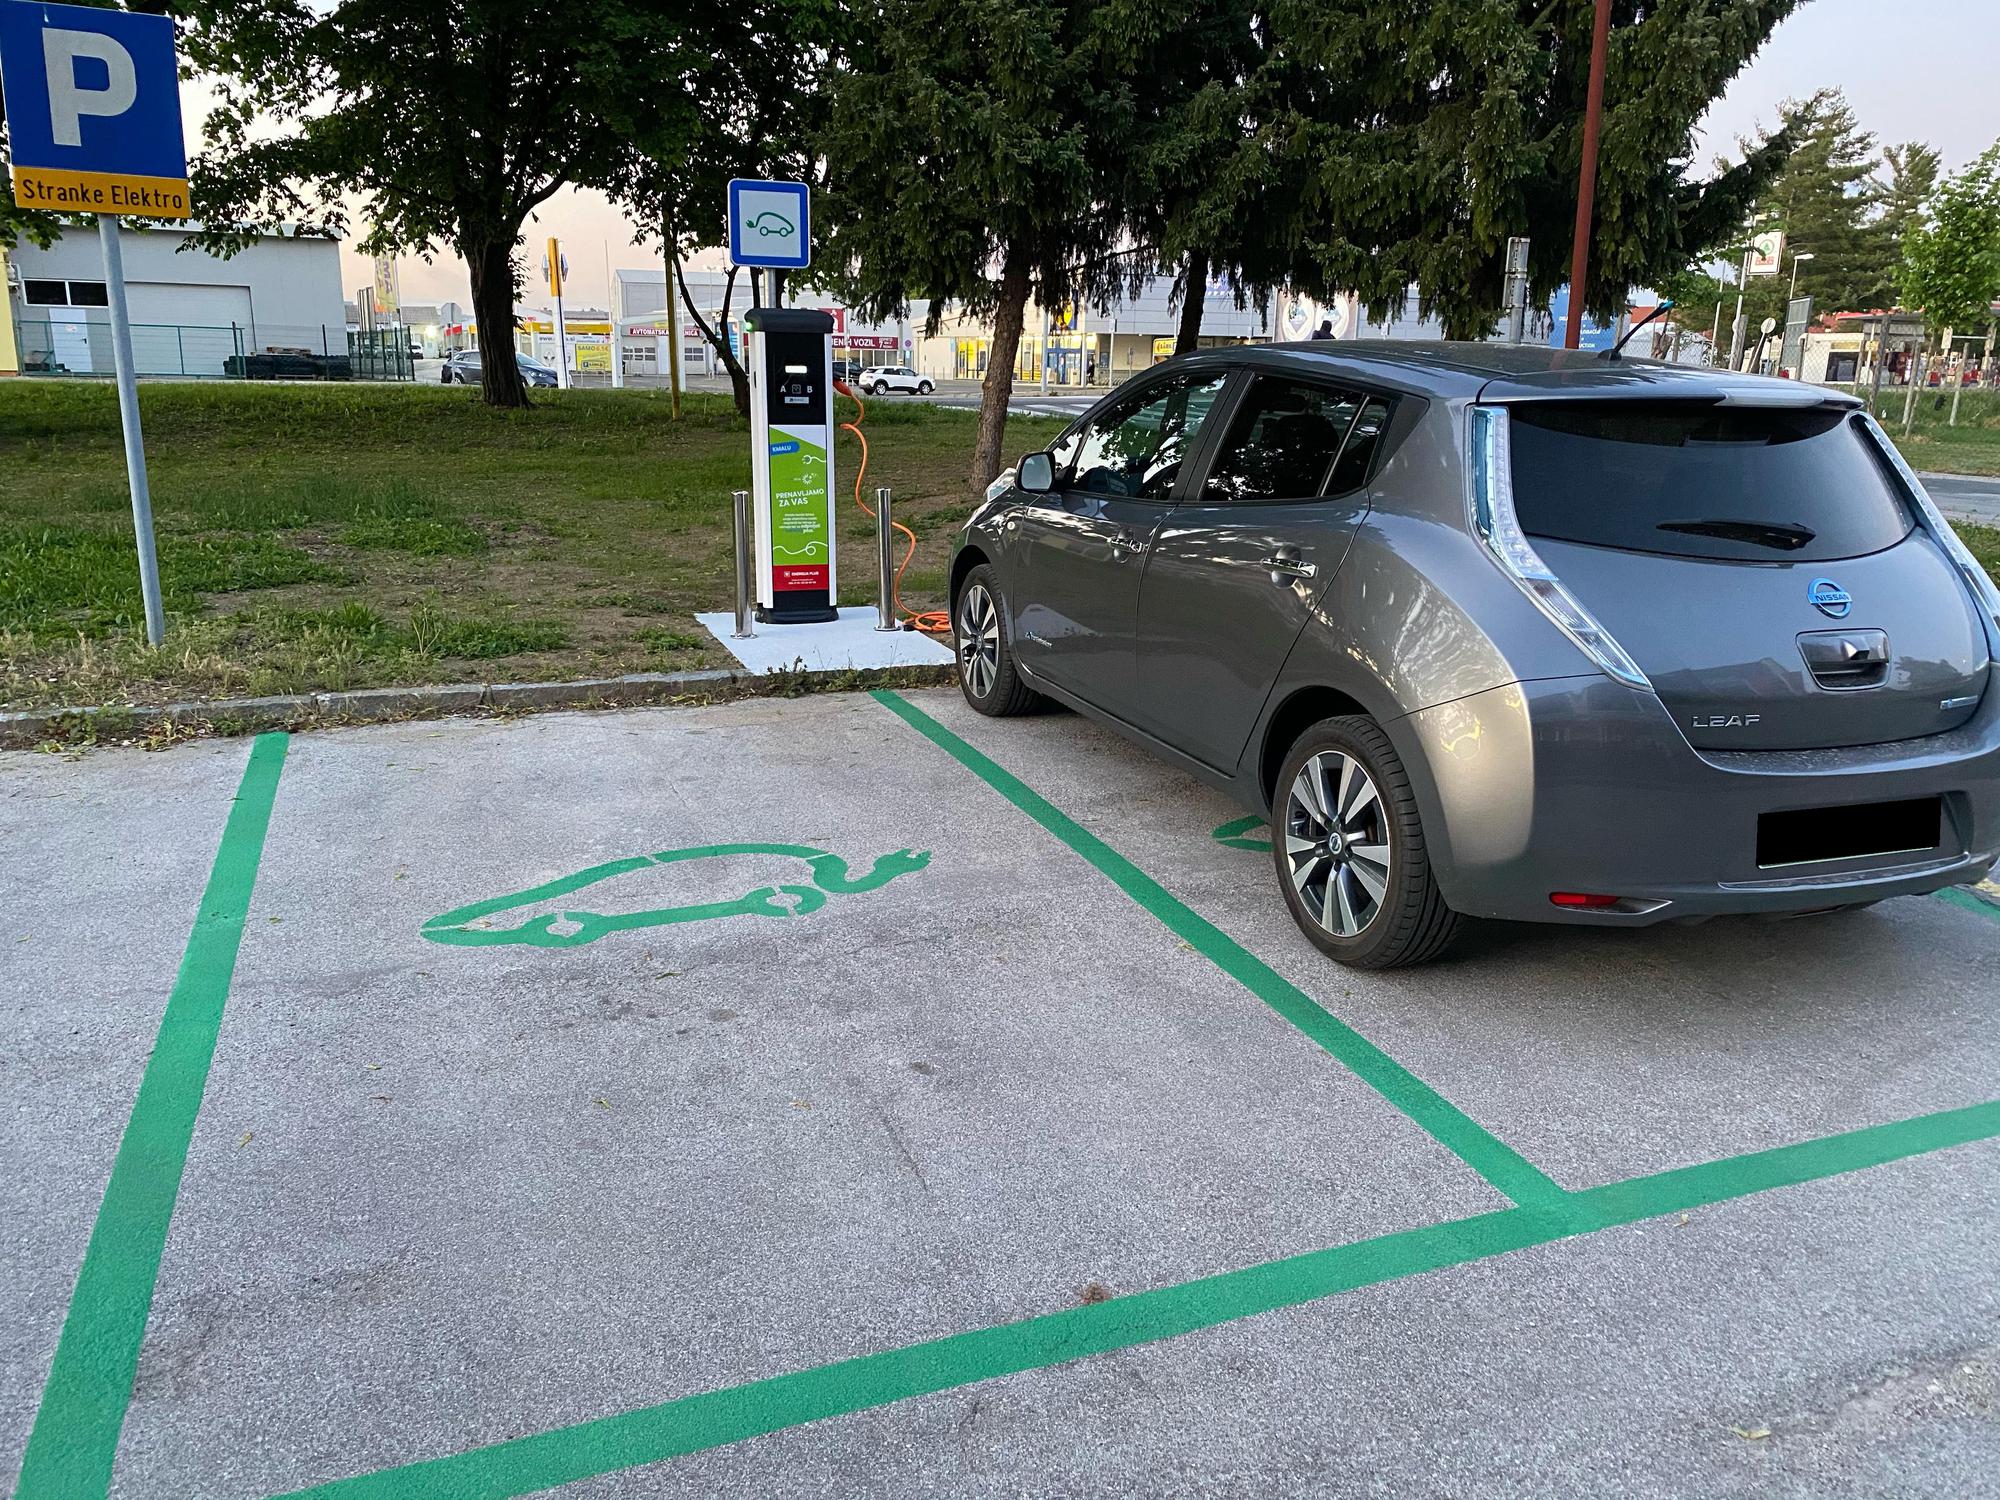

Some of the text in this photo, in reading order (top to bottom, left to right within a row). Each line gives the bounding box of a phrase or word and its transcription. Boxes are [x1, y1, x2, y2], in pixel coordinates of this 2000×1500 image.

[42, 27, 137, 147] P
[22, 178, 183, 209] Stranke Elektro
[853, 338, 876, 347] VOZIL
[780, 385, 813, 393] A B
[775, 488, 825, 500] PRENAVLJAMO
[779, 497, 809, 508] ZA VAS
[1815, 594, 1850, 602] NISSAN
[1692, 714, 1761, 728] LEAF
